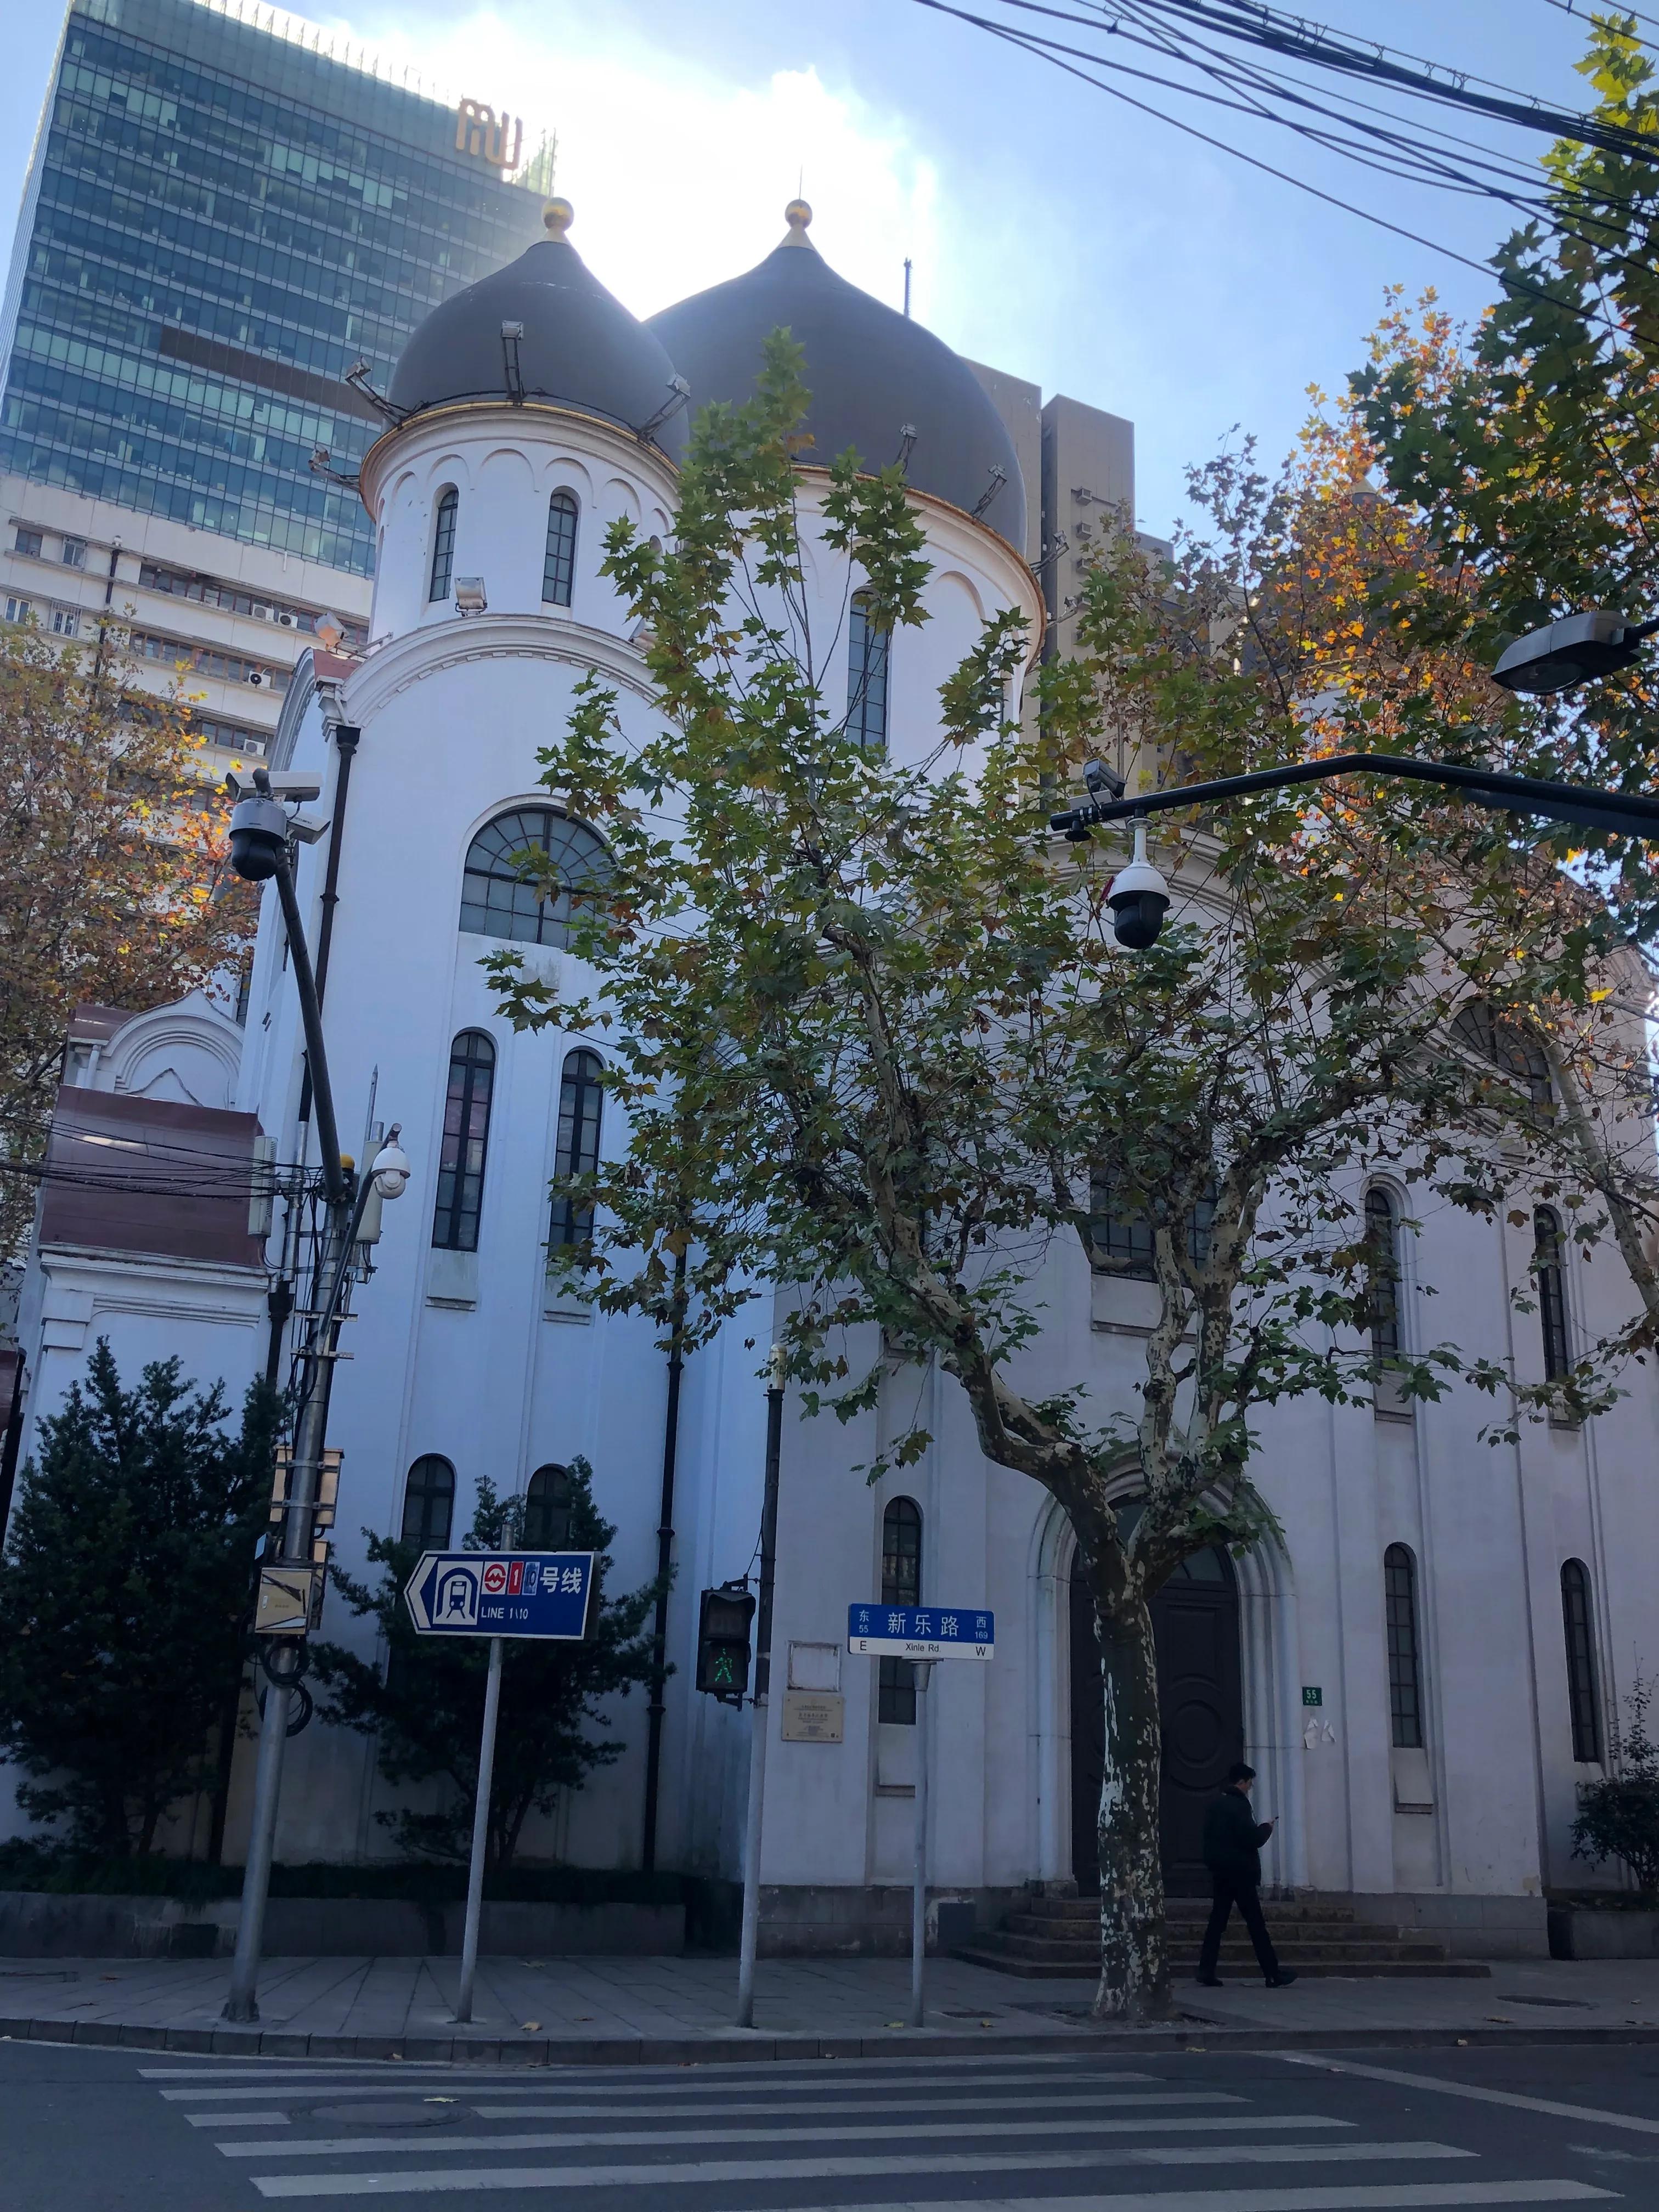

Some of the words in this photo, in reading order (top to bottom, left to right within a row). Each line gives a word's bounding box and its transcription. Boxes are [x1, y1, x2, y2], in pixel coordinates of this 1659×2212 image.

[540, 1567, 582, 1594] 号线
[481, 1606, 505, 1620] LINE
[859, 1610, 870, 1622] 东
[888, 1612, 959, 1637] 新乐路
[976, 1616, 988, 1628] 西
[859, 1624, 868, 1633] 55
[860, 1641, 867, 1651] E
[906, 1643, 925, 1651] Xinle
[975, 1646, 986, 1656] W
[1306, 1689, 1317, 1699] 55
